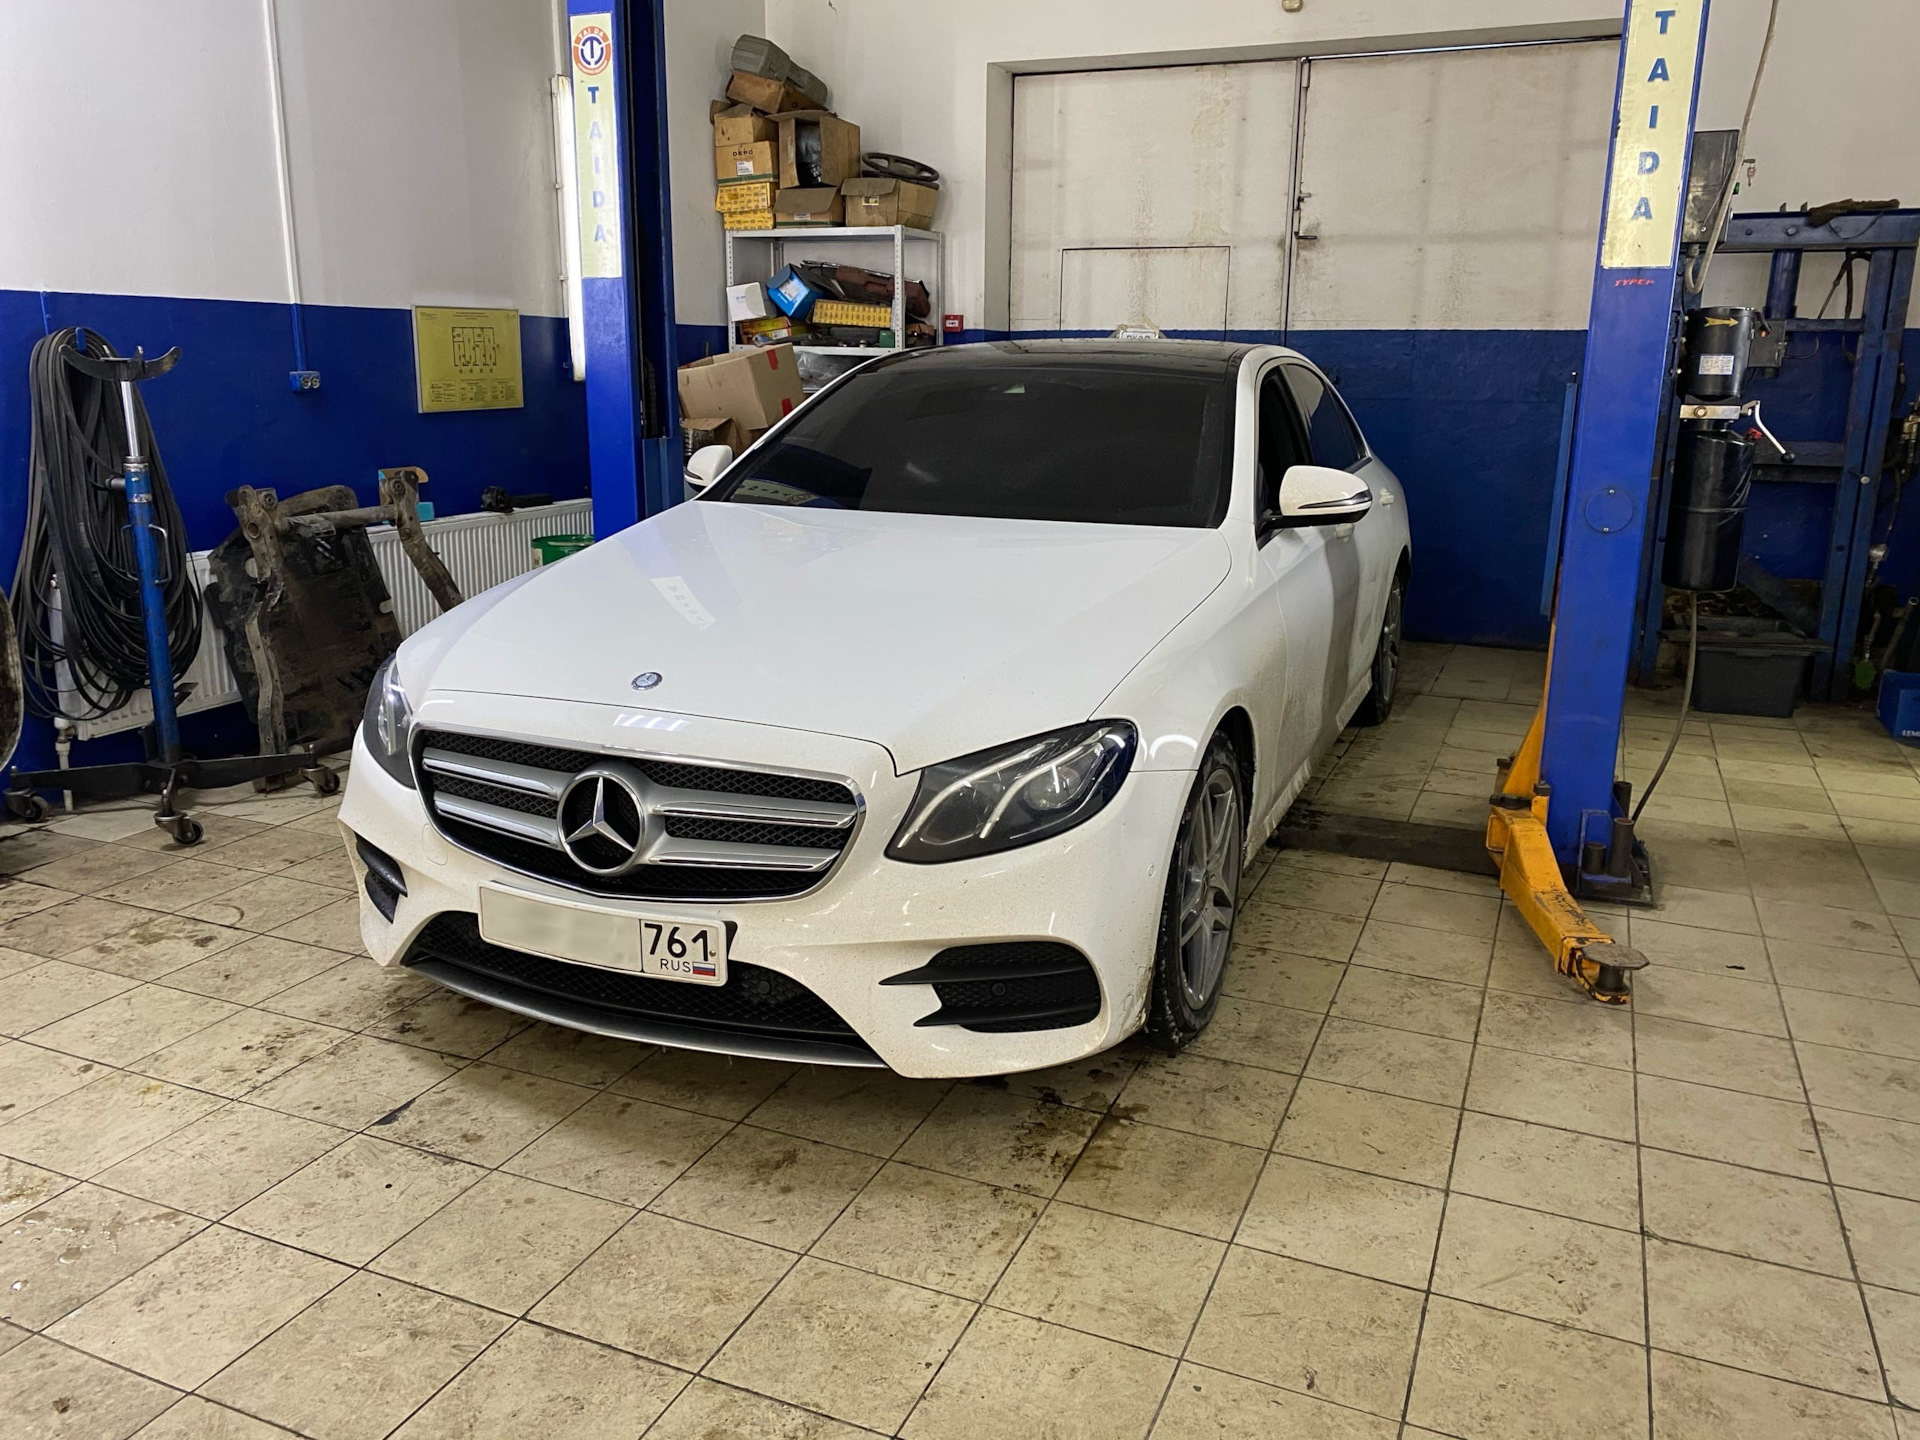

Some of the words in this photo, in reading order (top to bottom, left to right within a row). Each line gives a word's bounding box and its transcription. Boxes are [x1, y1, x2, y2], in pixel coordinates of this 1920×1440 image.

[1630, 9, 1677, 221] TAIDA
[587, 85, 607, 242] TAIDA
[732, 149, 754, 157] DEPO
[643, 922, 709, 962] 761
[660, 958, 692, 973] RUS
